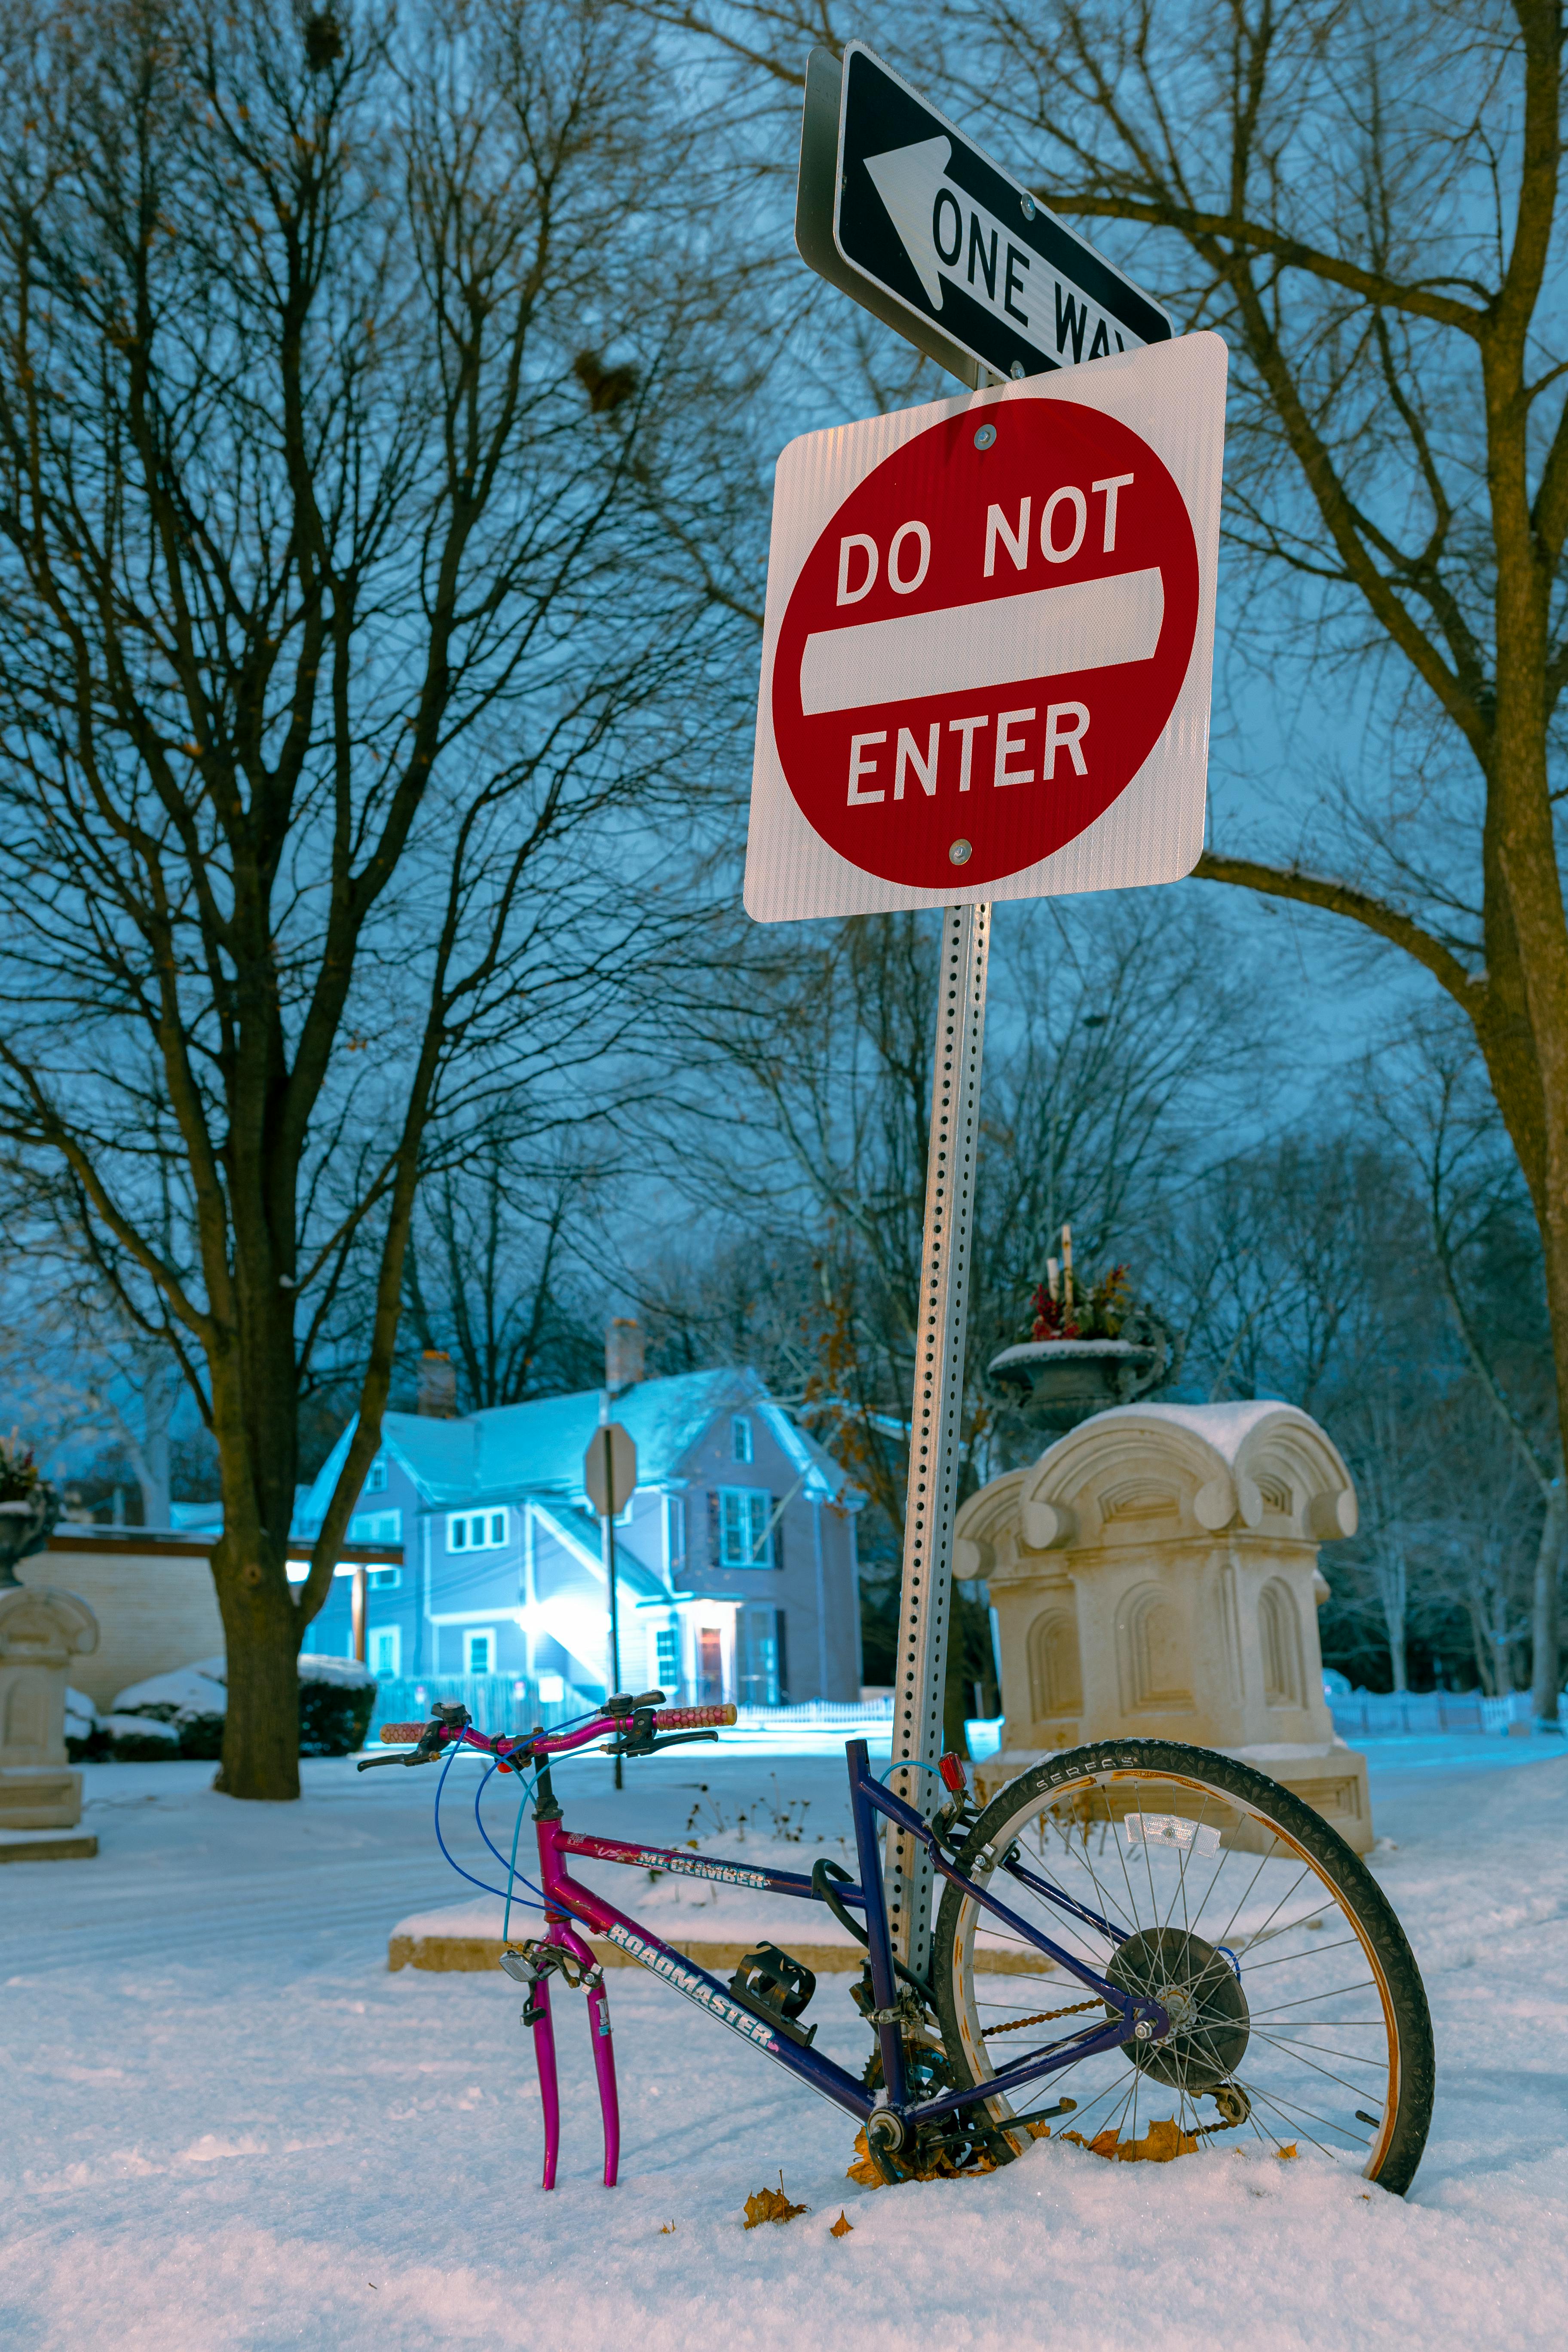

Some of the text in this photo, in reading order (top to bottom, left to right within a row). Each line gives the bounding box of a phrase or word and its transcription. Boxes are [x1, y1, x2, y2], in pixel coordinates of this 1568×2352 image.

[933, 187, 1125, 365] ONE WA
[836, 473, 1134, 606] DO NOT
[847, 701, 1091, 806] ENTER
[1036, 1757, 1134, 1792] SERFAS
[607, 1922, 775, 2049] ROADMASTER
